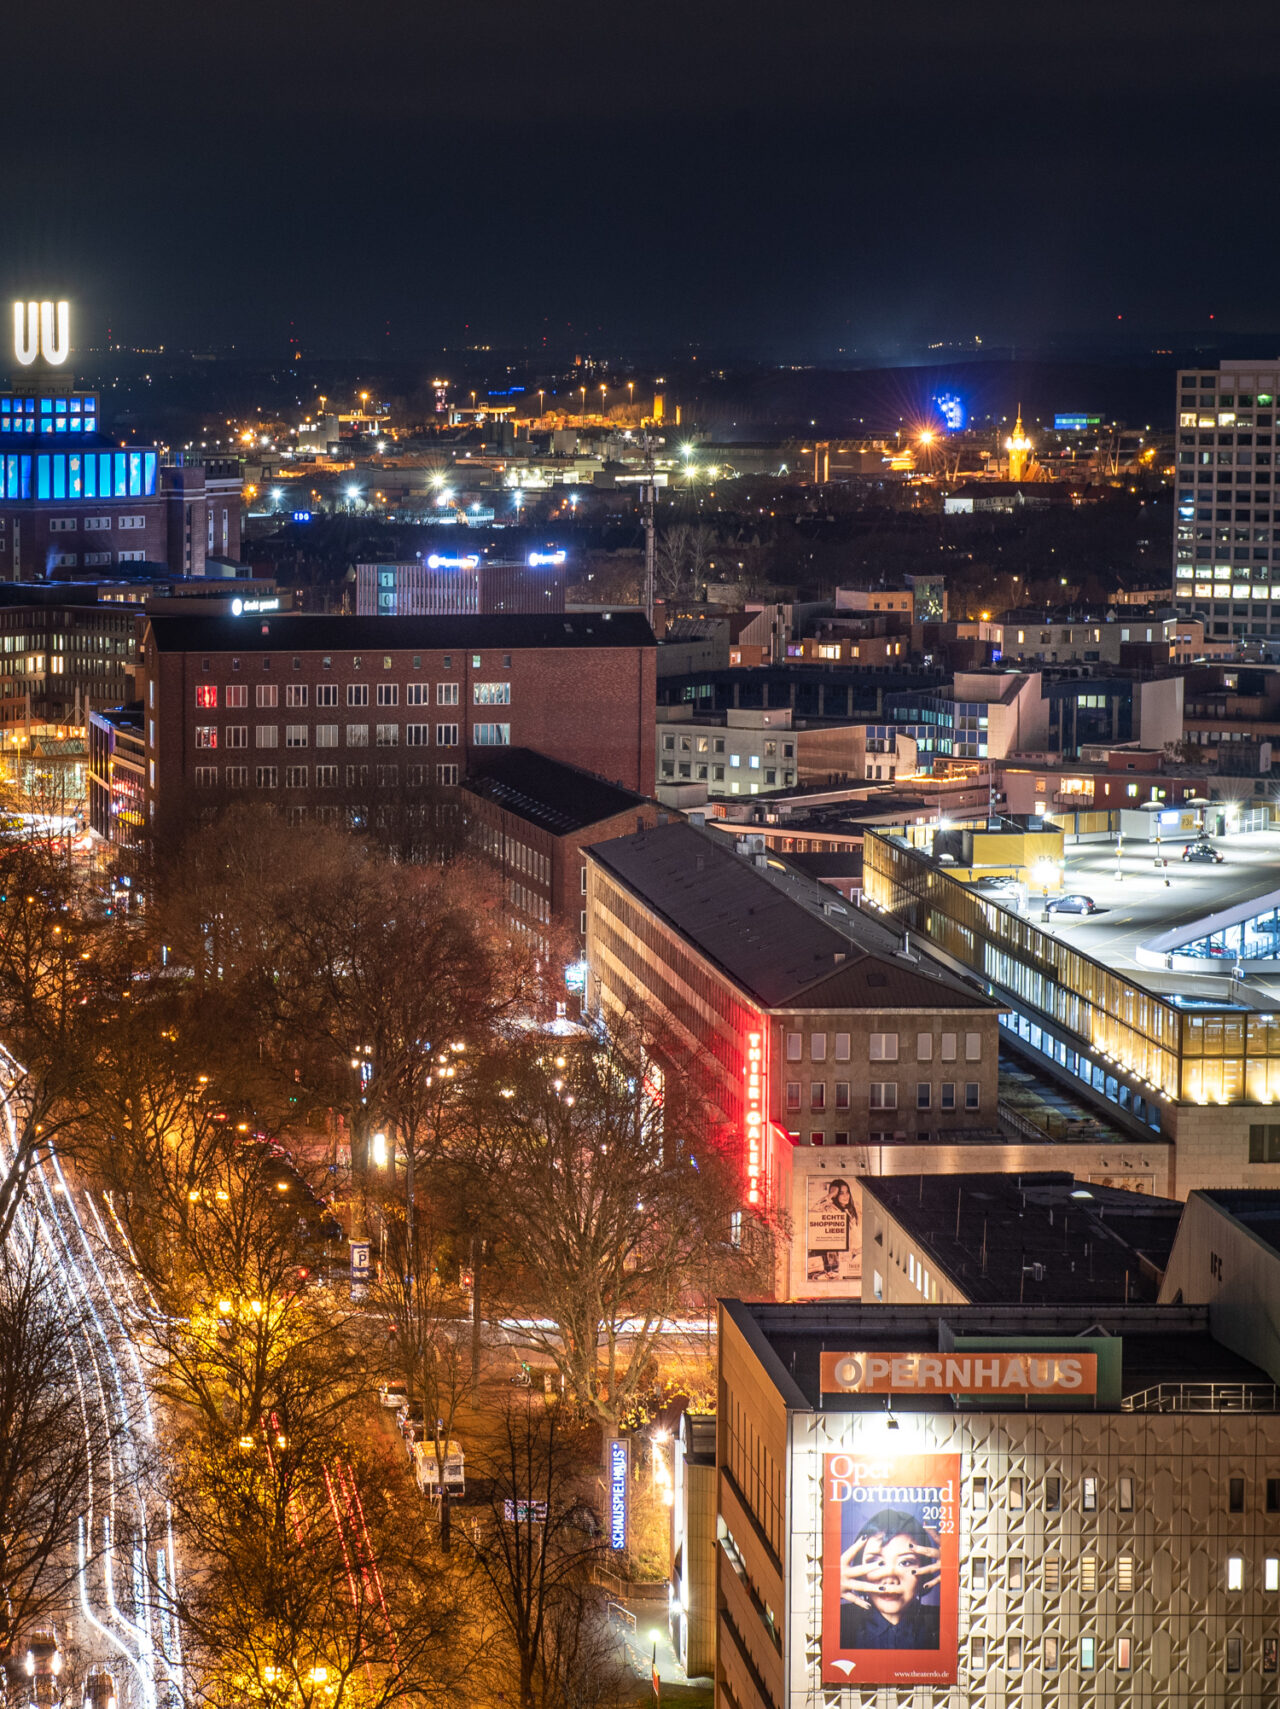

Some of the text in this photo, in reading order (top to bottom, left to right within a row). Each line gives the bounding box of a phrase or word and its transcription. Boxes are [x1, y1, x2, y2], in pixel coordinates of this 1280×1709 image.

[358, 1254, 367, 1266] P
[834, 1358, 1083, 1389] OPERNHAUS
[830, 1455, 894, 1486] Oper
[829, 1479, 954, 1503] Dortmund
[922, 1506, 953, 1520] 2021
